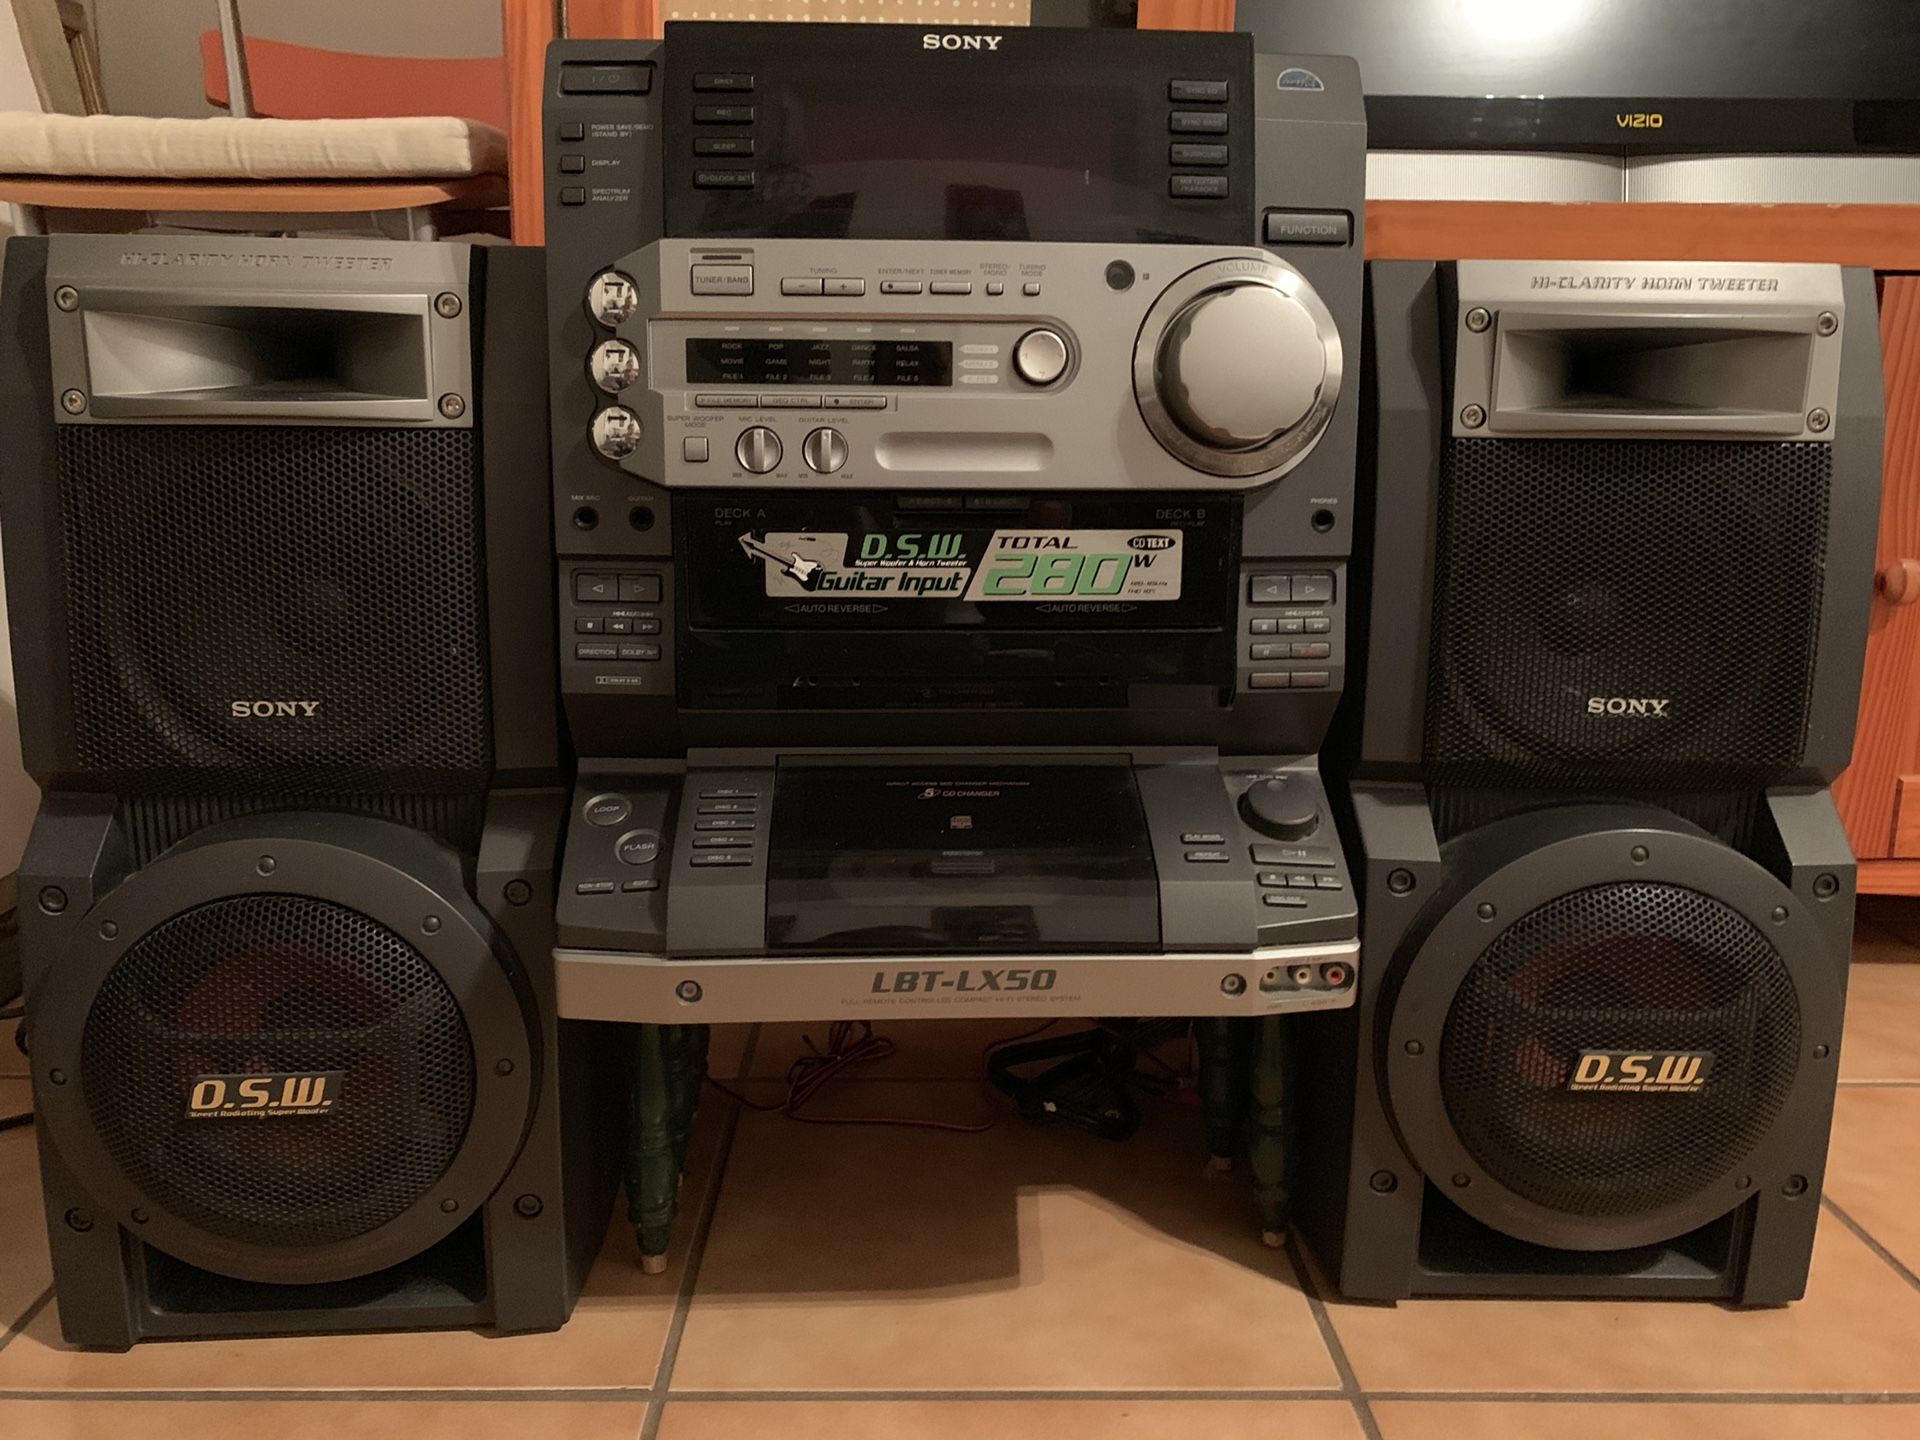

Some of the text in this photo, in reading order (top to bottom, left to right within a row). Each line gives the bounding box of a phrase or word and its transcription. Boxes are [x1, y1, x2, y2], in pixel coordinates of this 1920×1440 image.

[922, 34, 1003, 50] SONY
[1616, 113, 1663, 128] VIZIO
[591, 159, 621, 167] DISPLAY
[1280, 225, 1337, 235] FUNCTION
[119, 252, 393, 271] HI-CLARITY HORN TWEETER
[1216, 262, 1269, 274] VOLUME
[1530, 276, 1779, 291] HI-CLARITY HORN TWEETER
[895, 344, 919, 352] SALSA
[895, 360, 920, 368] RELAX
[853, 374, 869, 382] FILE
[714, 507, 767, 519] DECK A
[1156, 509, 1206, 520] DECK B
[996, 536, 1079, 549] TOTAL
[1146, 537, 1170, 549] TEXT
[854, 559, 878, 568] Super
[879, 559, 907, 567] Woofer
[915, 559, 935, 567] Horn
[936, 559, 968, 567] Tweeter
[982, 553, 1158, 596] 280 W
[816, 571, 963, 596] Guitar Input
[800, 604, 872, 613] AUTO REVERSE
[1050, 604, 1121, 613] AUTO REVERSE
[578, 648, 617, 656] DIRECTION
[621, 648, 645, 656] DOLBY
[231, 700, 320, 717] SONY
[1587, 697, 1670, 714] SONY
[941, 790, 956, 798] CD
[957, 790, 1000, 798] CHANGER
[593, 805, 621, 814] LOOP
[623, 843, 656, 852] FLASH
[871, 969, 1058, 993] LBT-LX50
[1049, 995, 1081, 1003] SYSTEM
[1575, 1055, 1705, 1085] D.S.W.
[190, 1077, 333, 1110] D.S.W.
[220, 1109, 266, 1119] Radiating
